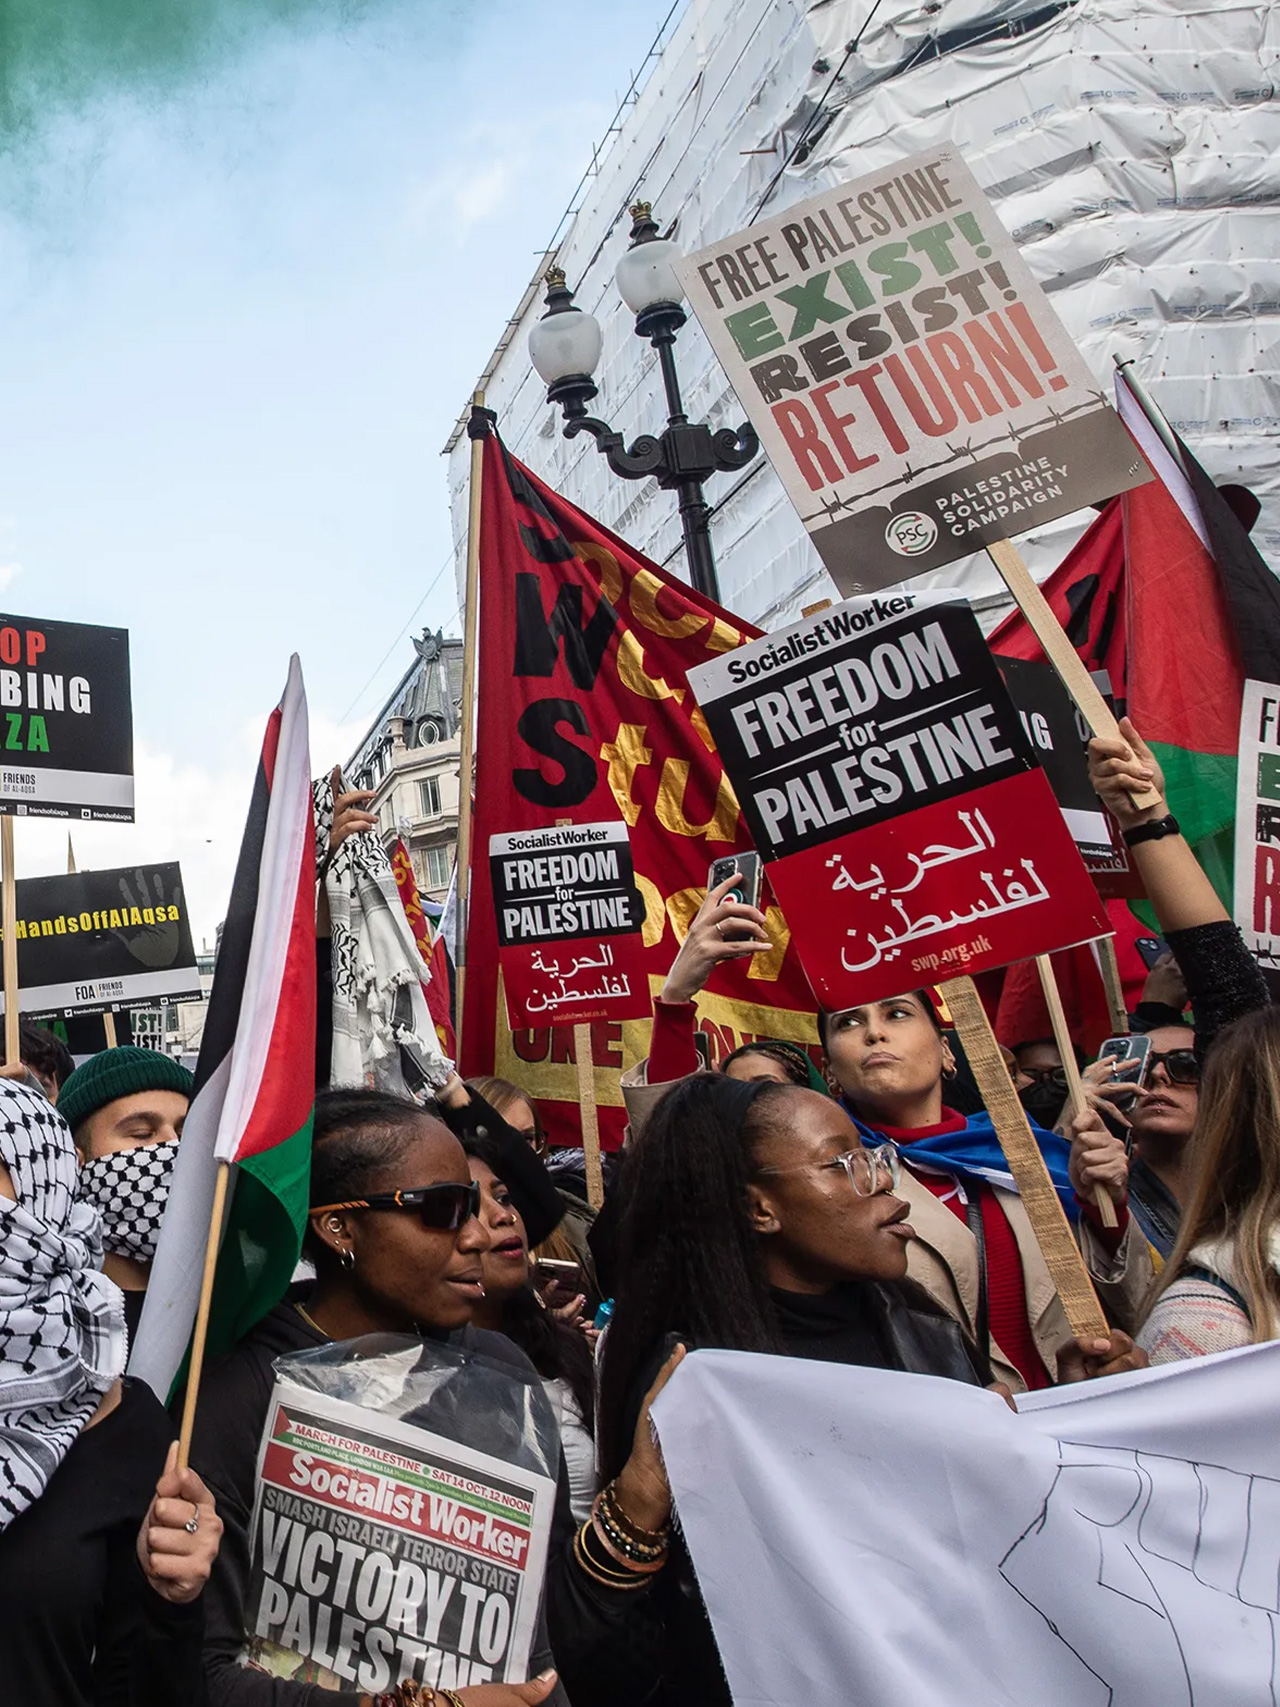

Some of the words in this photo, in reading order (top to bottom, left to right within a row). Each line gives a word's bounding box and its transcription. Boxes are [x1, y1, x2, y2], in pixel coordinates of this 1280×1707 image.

[697, 236, 789, 309] FREE
[780, 160, 962, 272] PALESTINE
[724, 211, 993, 363] EXIST!
[750, 261, 1017, 404] RESIST!
[771, 302, 1069, 492] RETURN!
[935, 456, 1052, 510] PALESTINE
[943, 465, 1069, 523] SOLIDARITY
[896, 523, 928, 545] PSC
[951, 485, 1063, 536] CAMPAIGN
[727, 624, 828, 684] Socialist
[823, 595, 917, 642] Worker
[730, 621, 962, 758] FREEDOM
[839, 720, 878, 753] for
[3, 772, 36, 785] FRIENDS
[753, 704, 1015, 845] PALESTINE
[508, 834, 562, 850] Socialist
[564, 830, 608, 845] Worker
[826, 808, 997, 900] الحرية
[503, 850, 620, 891] FREEDOM
[555, 886, 576, 901] for
[503, 896, 633, 938] PALESTINE
[841, 858, 1051, 973] لفلسطين
[531, 944, 614, 979] الحرية
[911, 935, 993, 972] swp.org.uk
[75, 985, 96, 1000] FOA
[98, 981, 124, 991] FRIENDS
[526, 973, 631, 1012] لفلسطين
[131, 1013, 162, 1032] IST!
[295, 1425, 336, 1447] MARCH
[338, 1438, 360, 1453] FOR
[363, 1444, 421, 1473] PALESTINE
[431, 1469, 452, 1485] SAT
[453, 1477, 465, 1490] 14
[489, 1488, 501, 1501] 12
[502, 1493, 531, 1513] NOON
[289, 1451, 424, 1526] Socialist
[430, 1492, 528, 1562] Worker
[265, 1489, 322, 1526] SMASH
[328, 1512, 399, 1556] ISRAELI
[403, 1537, 468, 1579] TERROR
[470, 1563, 517, 1595] STATE
[261, 1508, 464, 1645] VICTORY
[461, 1583, 511, 1665] TO
